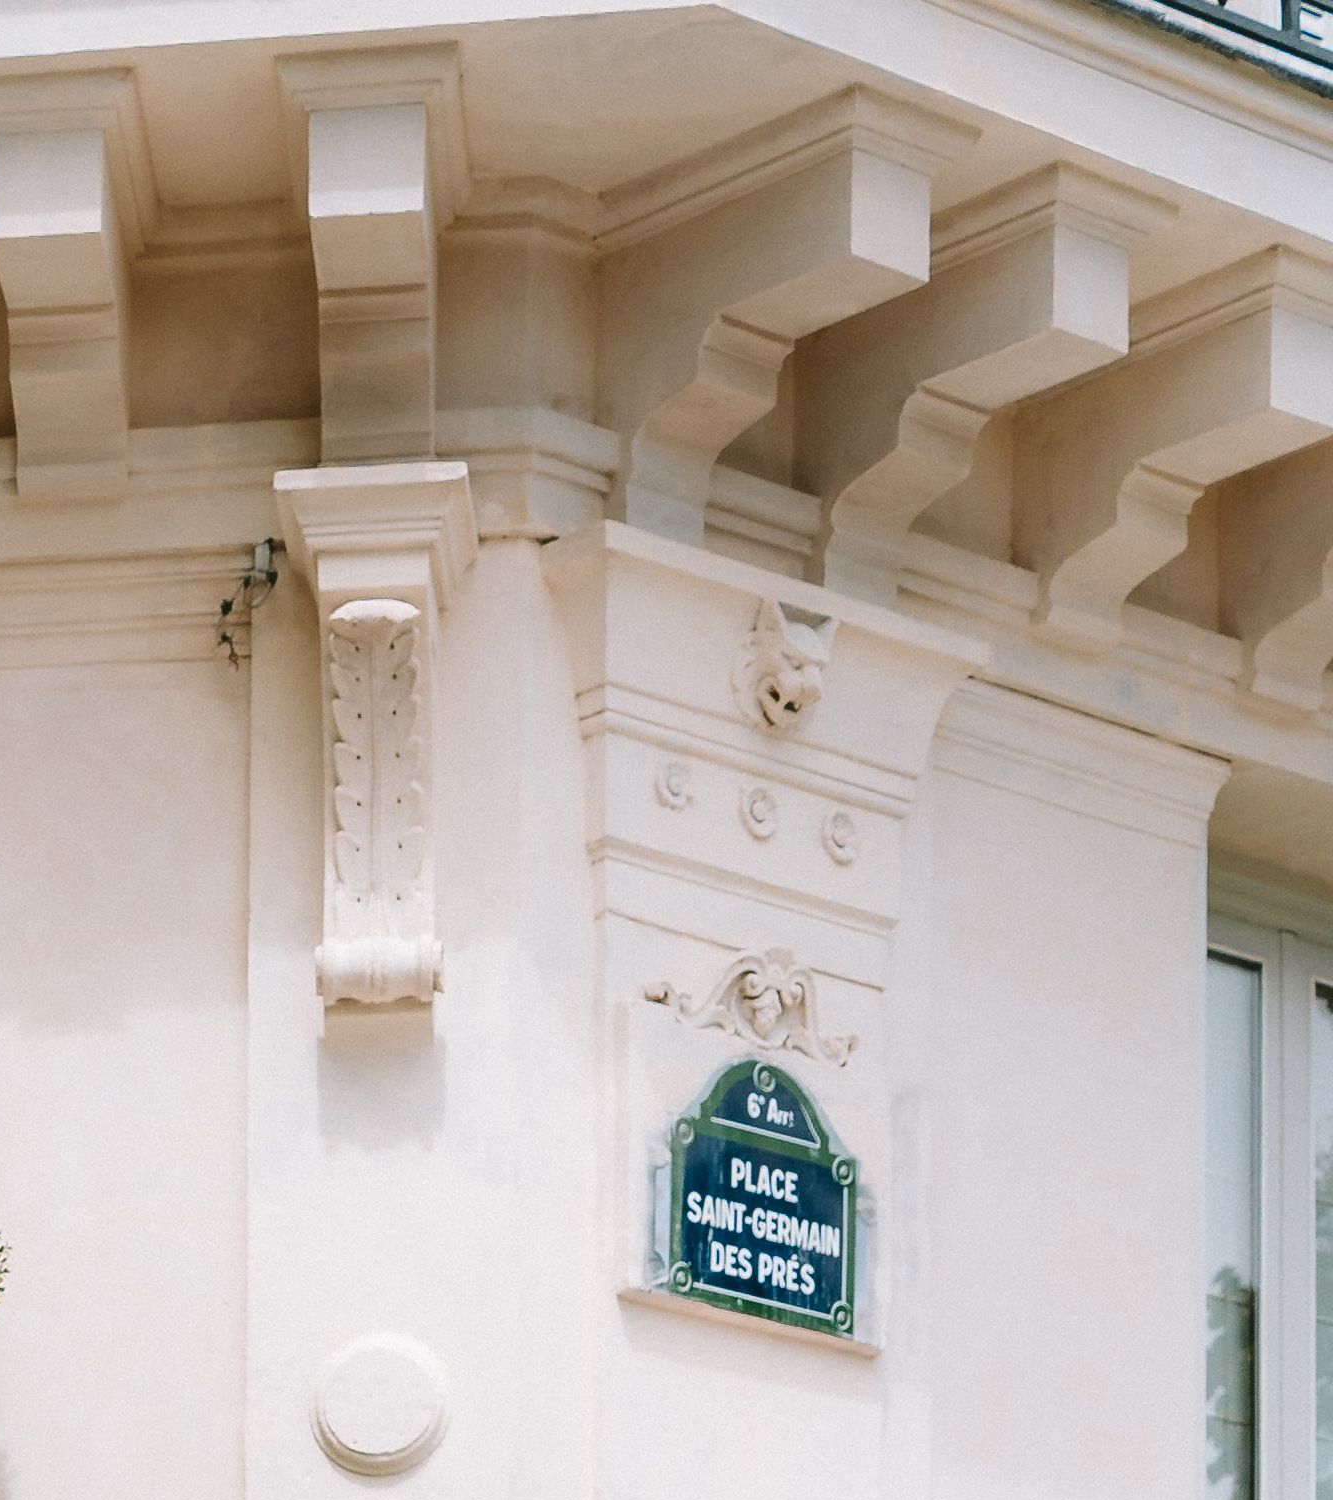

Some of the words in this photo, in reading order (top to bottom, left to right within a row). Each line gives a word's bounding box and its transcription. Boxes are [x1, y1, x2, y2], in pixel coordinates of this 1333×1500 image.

[730, 1157, 799, 1204] PLACE
[686, 1191, 841, 1259] SAINT-GERMAIN
[710, 1240, 753, 1281] DES
[757, 1253, 816, 1297] PRÉS
